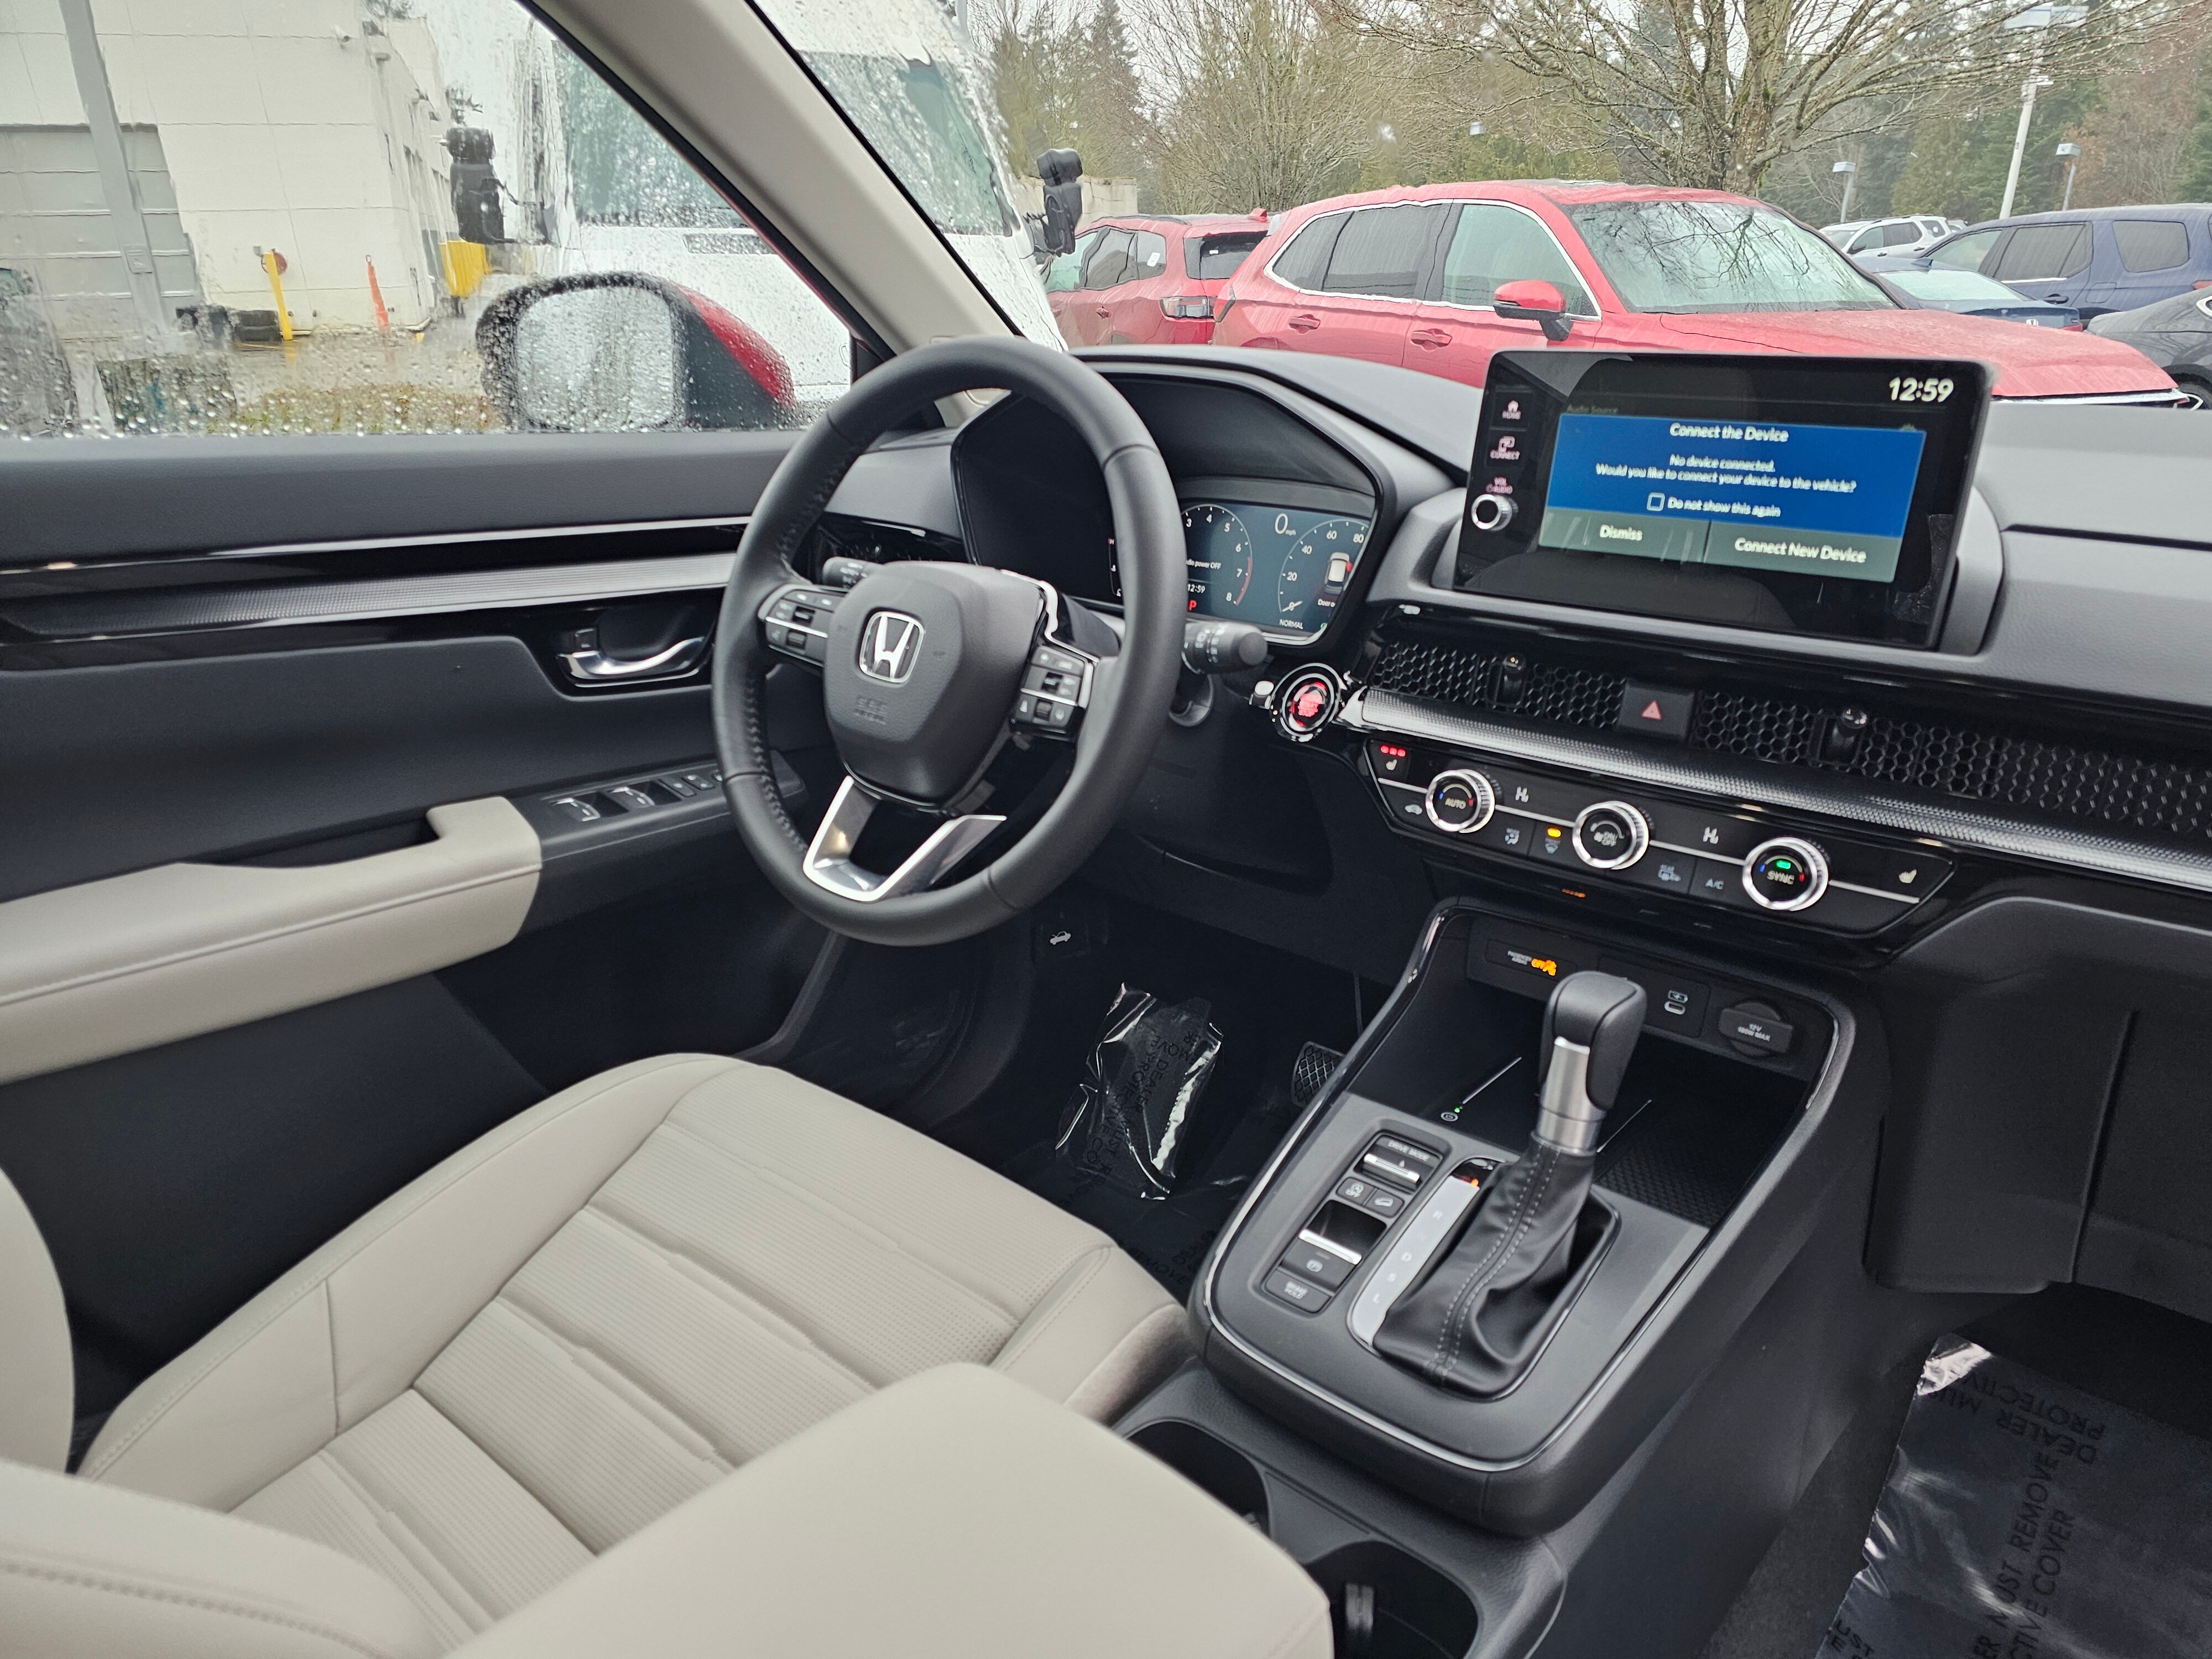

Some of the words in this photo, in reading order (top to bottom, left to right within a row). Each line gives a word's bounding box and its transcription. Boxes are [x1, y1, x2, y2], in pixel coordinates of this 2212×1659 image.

[1888, 378, 1954, 402] 12:59
[1670, 422, 1719, 439] Connect
[1721, 425, 1743, 440] the
[1744, 426, 1789, 442] Device
[1670, 454, 1686, 467] No
[1687, 455, 1719, 469] device
[1719, 458, 1776, 473] connected.
[1596, 462, 1628, 476] Would
[1628, 467, 1647, 479] you
[1647, 466, 1665, 479] like
[1665, 468, 1677, 481] to
[1677, 470, 1718, 483] connect
[1719, 473, 1743, 485] your
[1744, 473, 1778, 488] device
[1778, 476, 1791, 489] to
[1792, 477, 1812, 490] the
[1813, 479, 1857, 493] vehicle?
[1667, 497, 1684, 509] Do
[1684, 498, 1703, 511] not
[1703, 499, 1731, 513] show
[1731, 502, 1751, 515] this
[1751, 504, 1781, 518] again
[1186, 518, 1192, 528] 3
[1206, 514, 1213, 523] 4
[1275, 513, 1288, 534] 0
[1224, 522, 1230, 532] 5
[1599, 524, 1642, 541] Dismiss
[1326, 530, 1337, 540] 60
[1353, 533, 1364, 543] 80
[1235, 543, 1241, 552] 6
[1301, 545, 1313, 555] 40
[1734, 537, 1787, 556] Connect
[1788, 542, 1819, 559] New
[1819, 545, 1867, 564] Device
[1210, 562, 1222, 570] OFF
[1237, 568, 1243, 578] 7
[1286, 571, 1297, 582] 20
[1187, 583, 1206, 593] 12:59
[1226, 592, 1232, 602] 8
[1188, 599, 1197, 611] P
[1279, 619, 1303, 629] NORMAL
[1445, 799, 1467, 810] AUTO
[1766, 869, 1796, 885] SYNC
[1705, 878, 1724, 890] A/C
[1387, 1140, 1409, 1154] DRIVE
[1408, 1147, 1431, 1162] MODE
[2006, 1451, 2059, 1553] REMOVE
[2031, 1509, 2077, 1597] COVER
